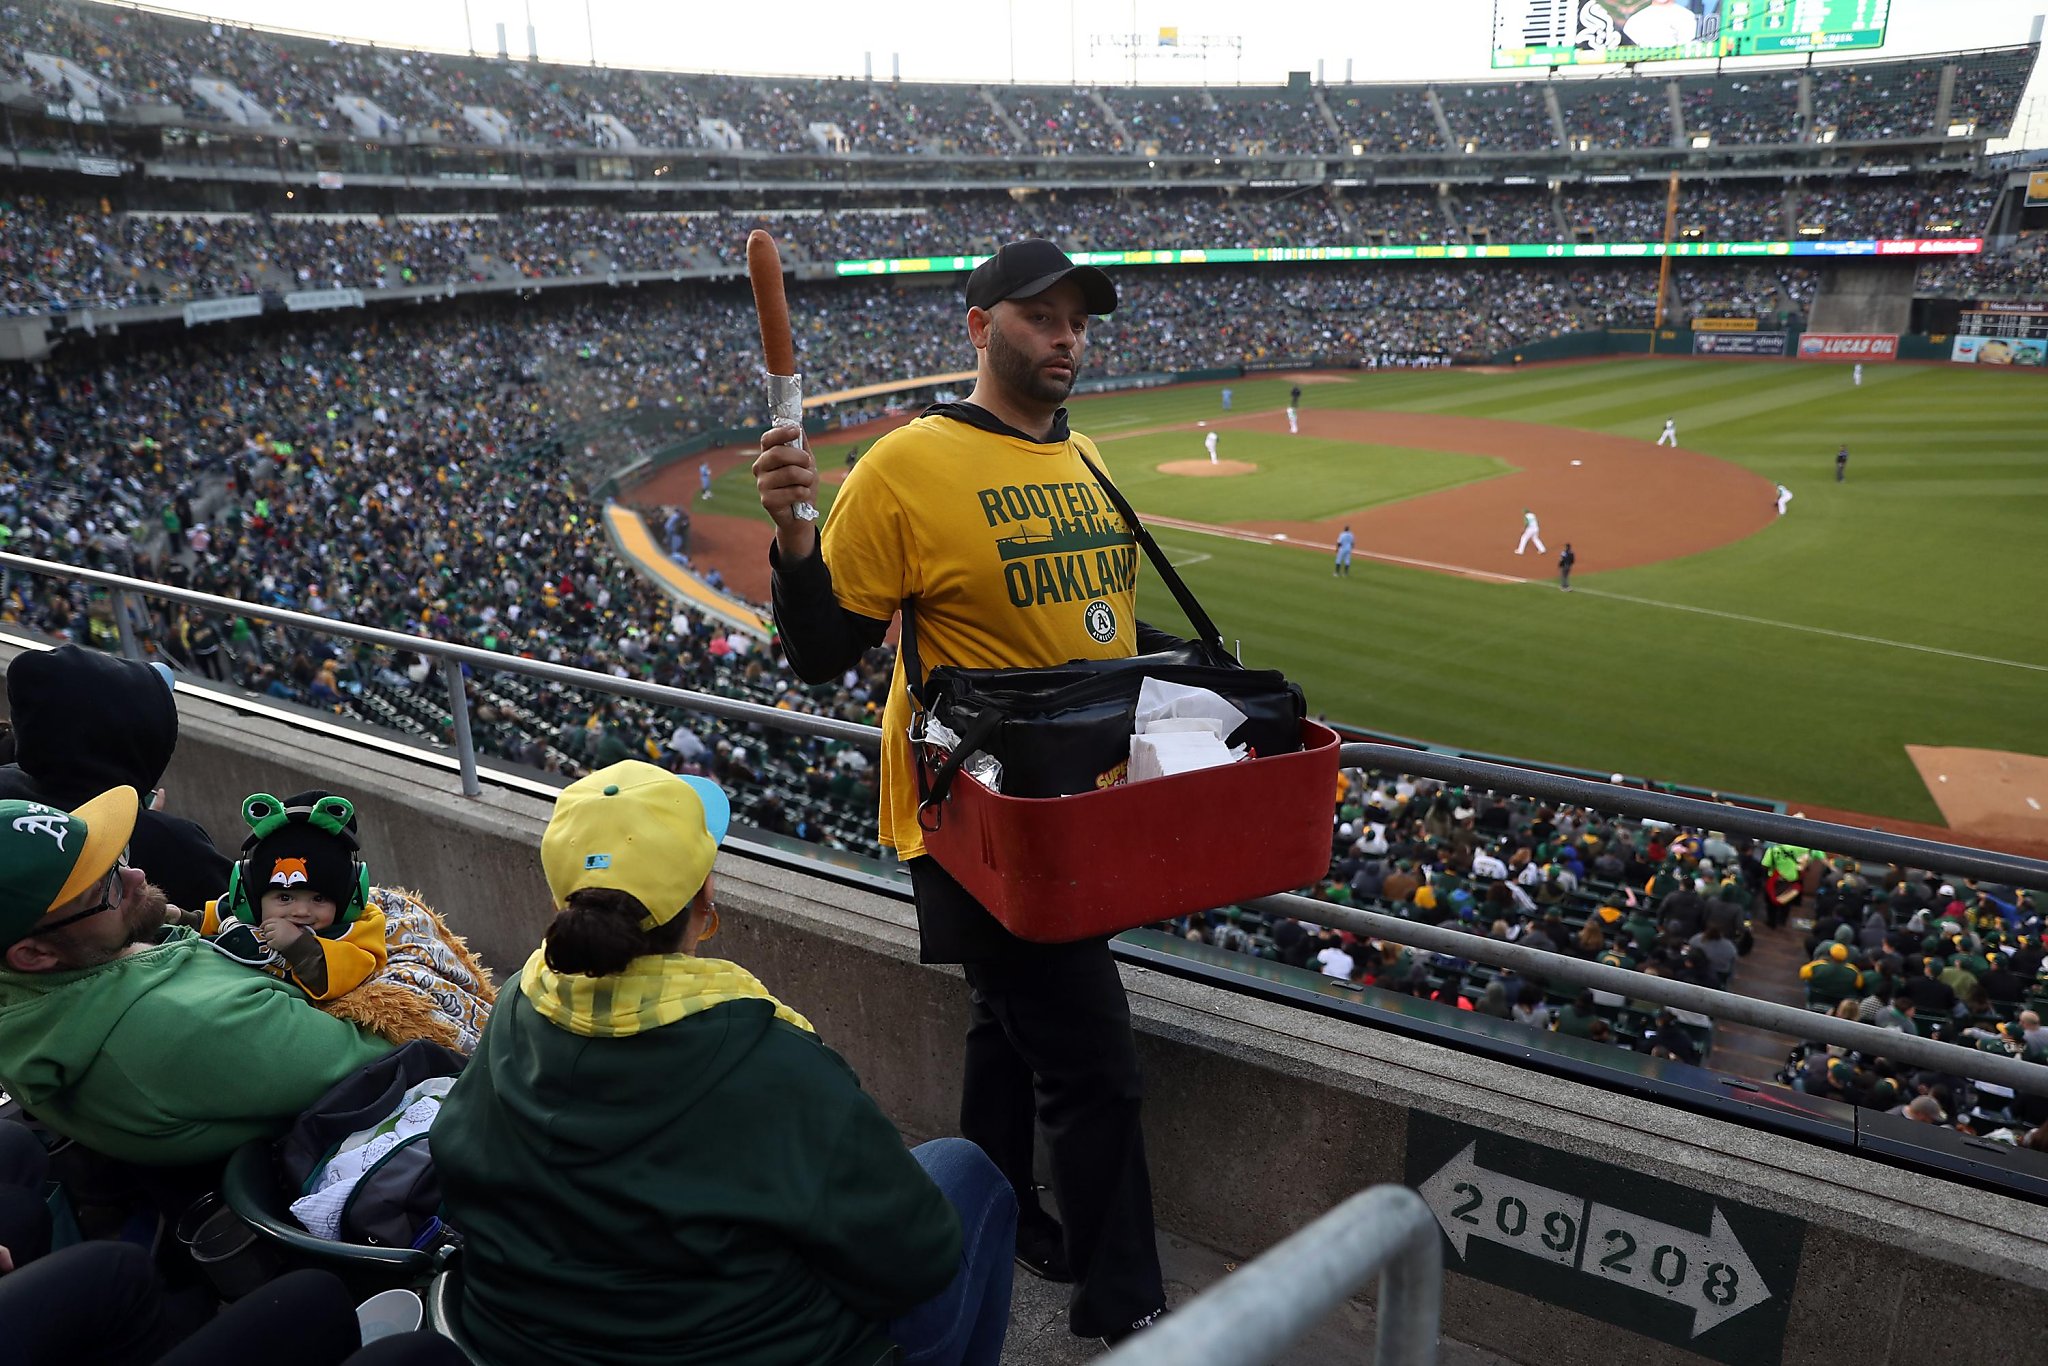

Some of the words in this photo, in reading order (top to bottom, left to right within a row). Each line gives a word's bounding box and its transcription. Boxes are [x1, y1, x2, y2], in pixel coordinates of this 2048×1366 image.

[1823, 338, 1869, 354] LUCAS
[1870, 339, 1894, 354] OIL
[976, 482, 1099, 528] ROOTED
[1092, 482, 1119, 514] I
[1003, 548, 1136, 608] OAKLAND
[1087, 602, 1110, 617] OAKLAND
[1095, 760, 1127, 790] SUPE
[1450, 1181, 1578, 1253] 209
[1599, 1228, 1740, 1307] 208
